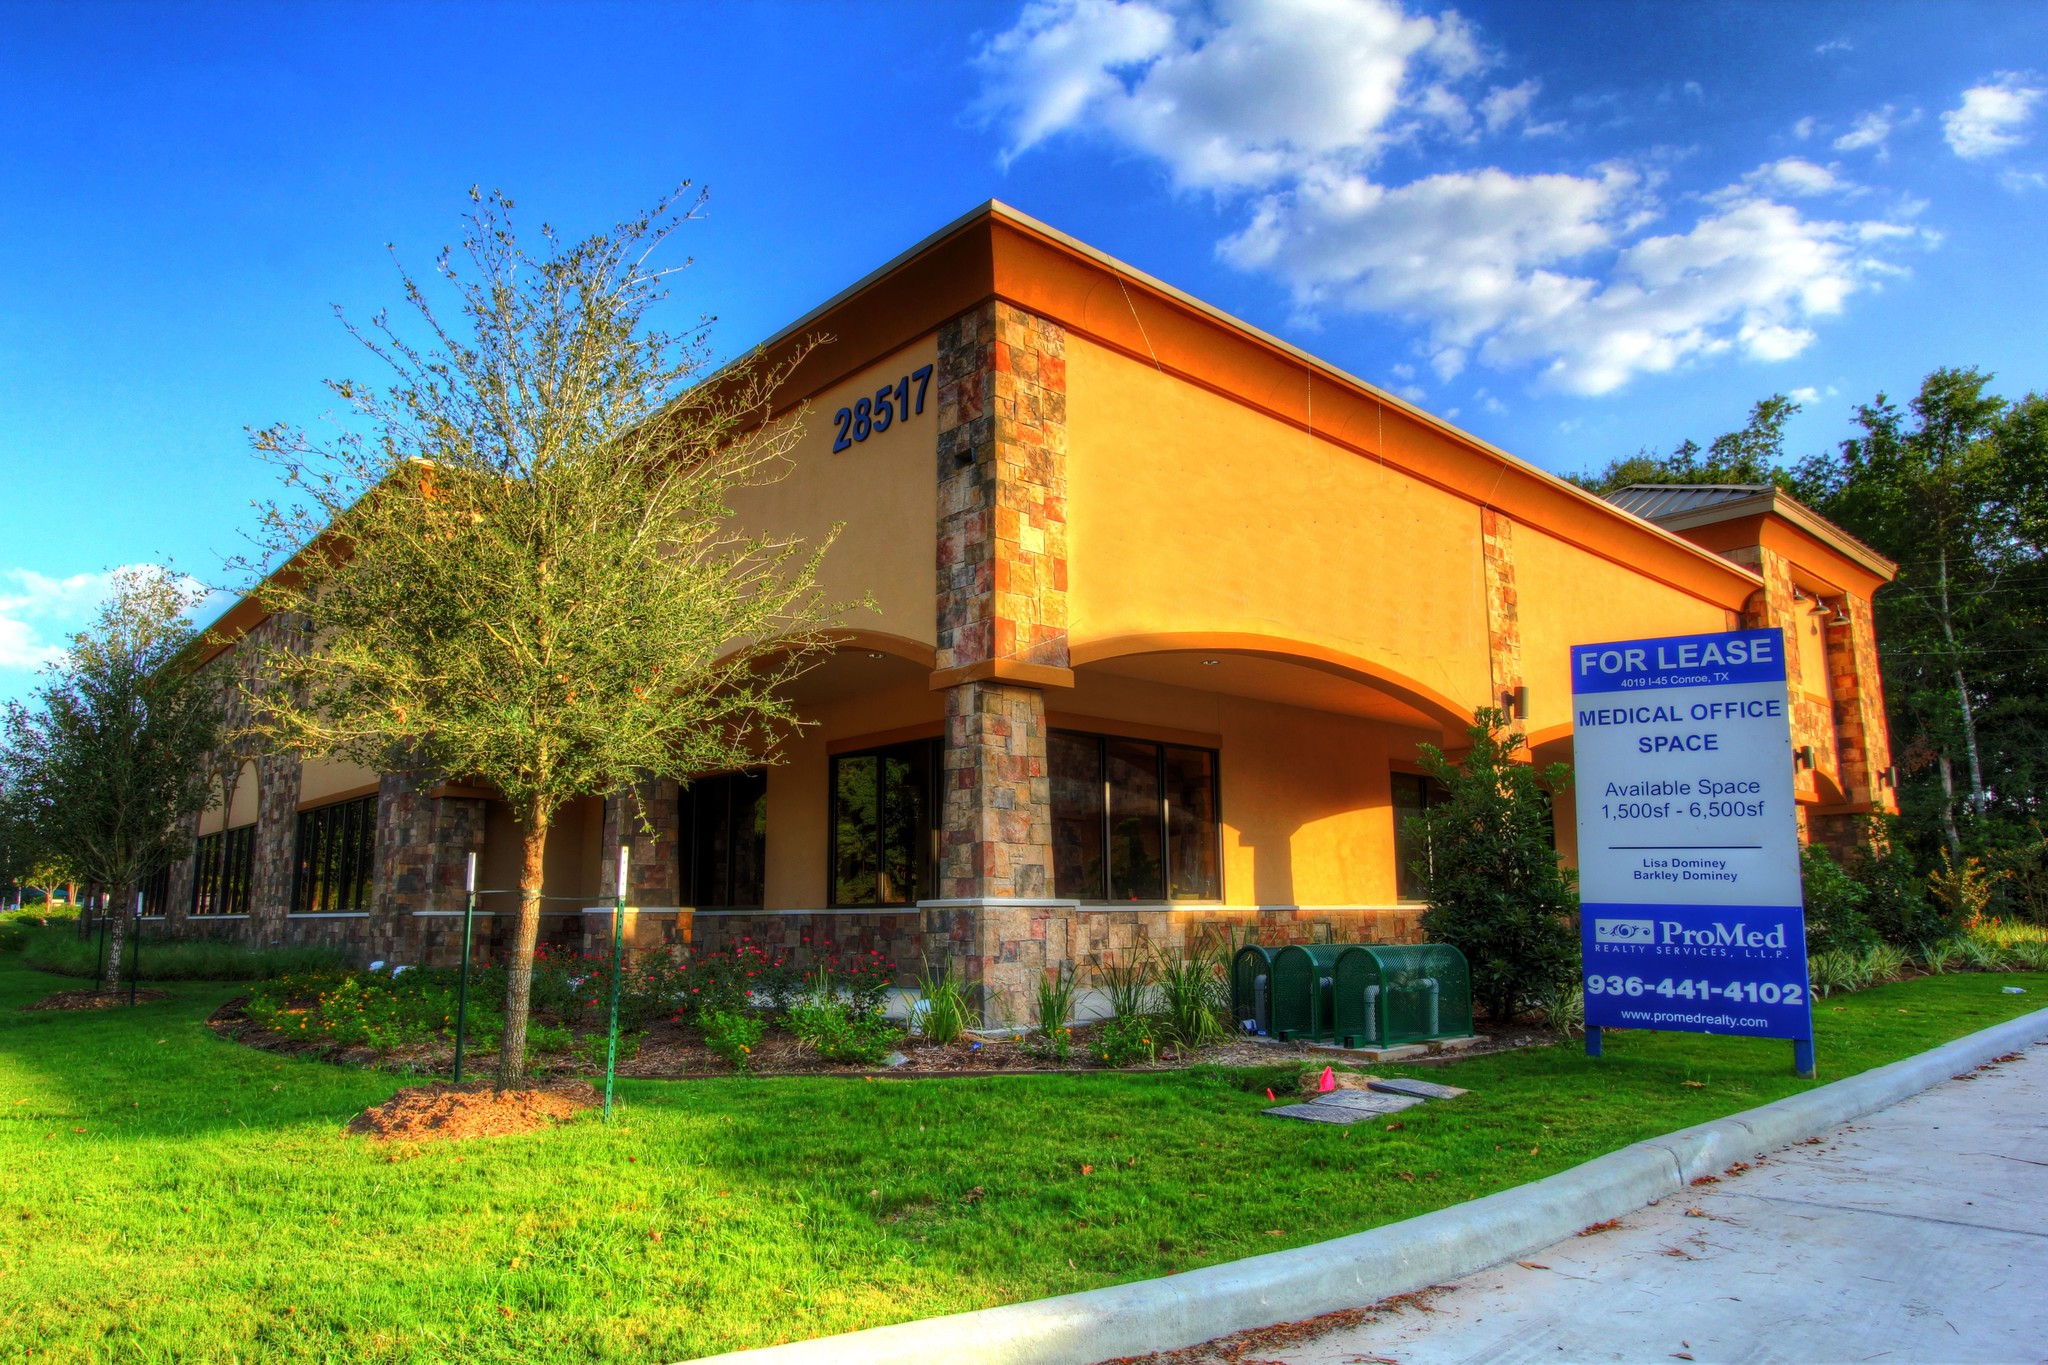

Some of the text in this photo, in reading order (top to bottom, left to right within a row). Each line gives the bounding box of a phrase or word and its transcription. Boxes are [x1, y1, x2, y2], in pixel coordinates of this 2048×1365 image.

[833, 364, 933, 454] 28517
[1580, 638, 1773, 676] FOR LEASE
[1621, 672, 1729, 688] 4019 I-45 Conroe, TX
[1579, 700, 1781, 727] MEDICAL OFFICE
[1638, 734, 1719, 753] SPACE
[1605, 779, 1761, 797] Available Space
[1601, 802, 1671, 820] 1,500sf
[1689, 801, 1765, 819] 6,500sf
[1643, 858, 1726, 870] Lisa Dominey
[1633, 870, 1738, 883] Barkley Dominey
[1659, 921, 1787, 949] ProMed
[1595, 945, 1789, 959] REALTY SERVICES, L.L.P.
[1587, 974, 1803, 1005] 936-441-4102
[1620, 1010, 1768, 1028] www.promedrealty.com
